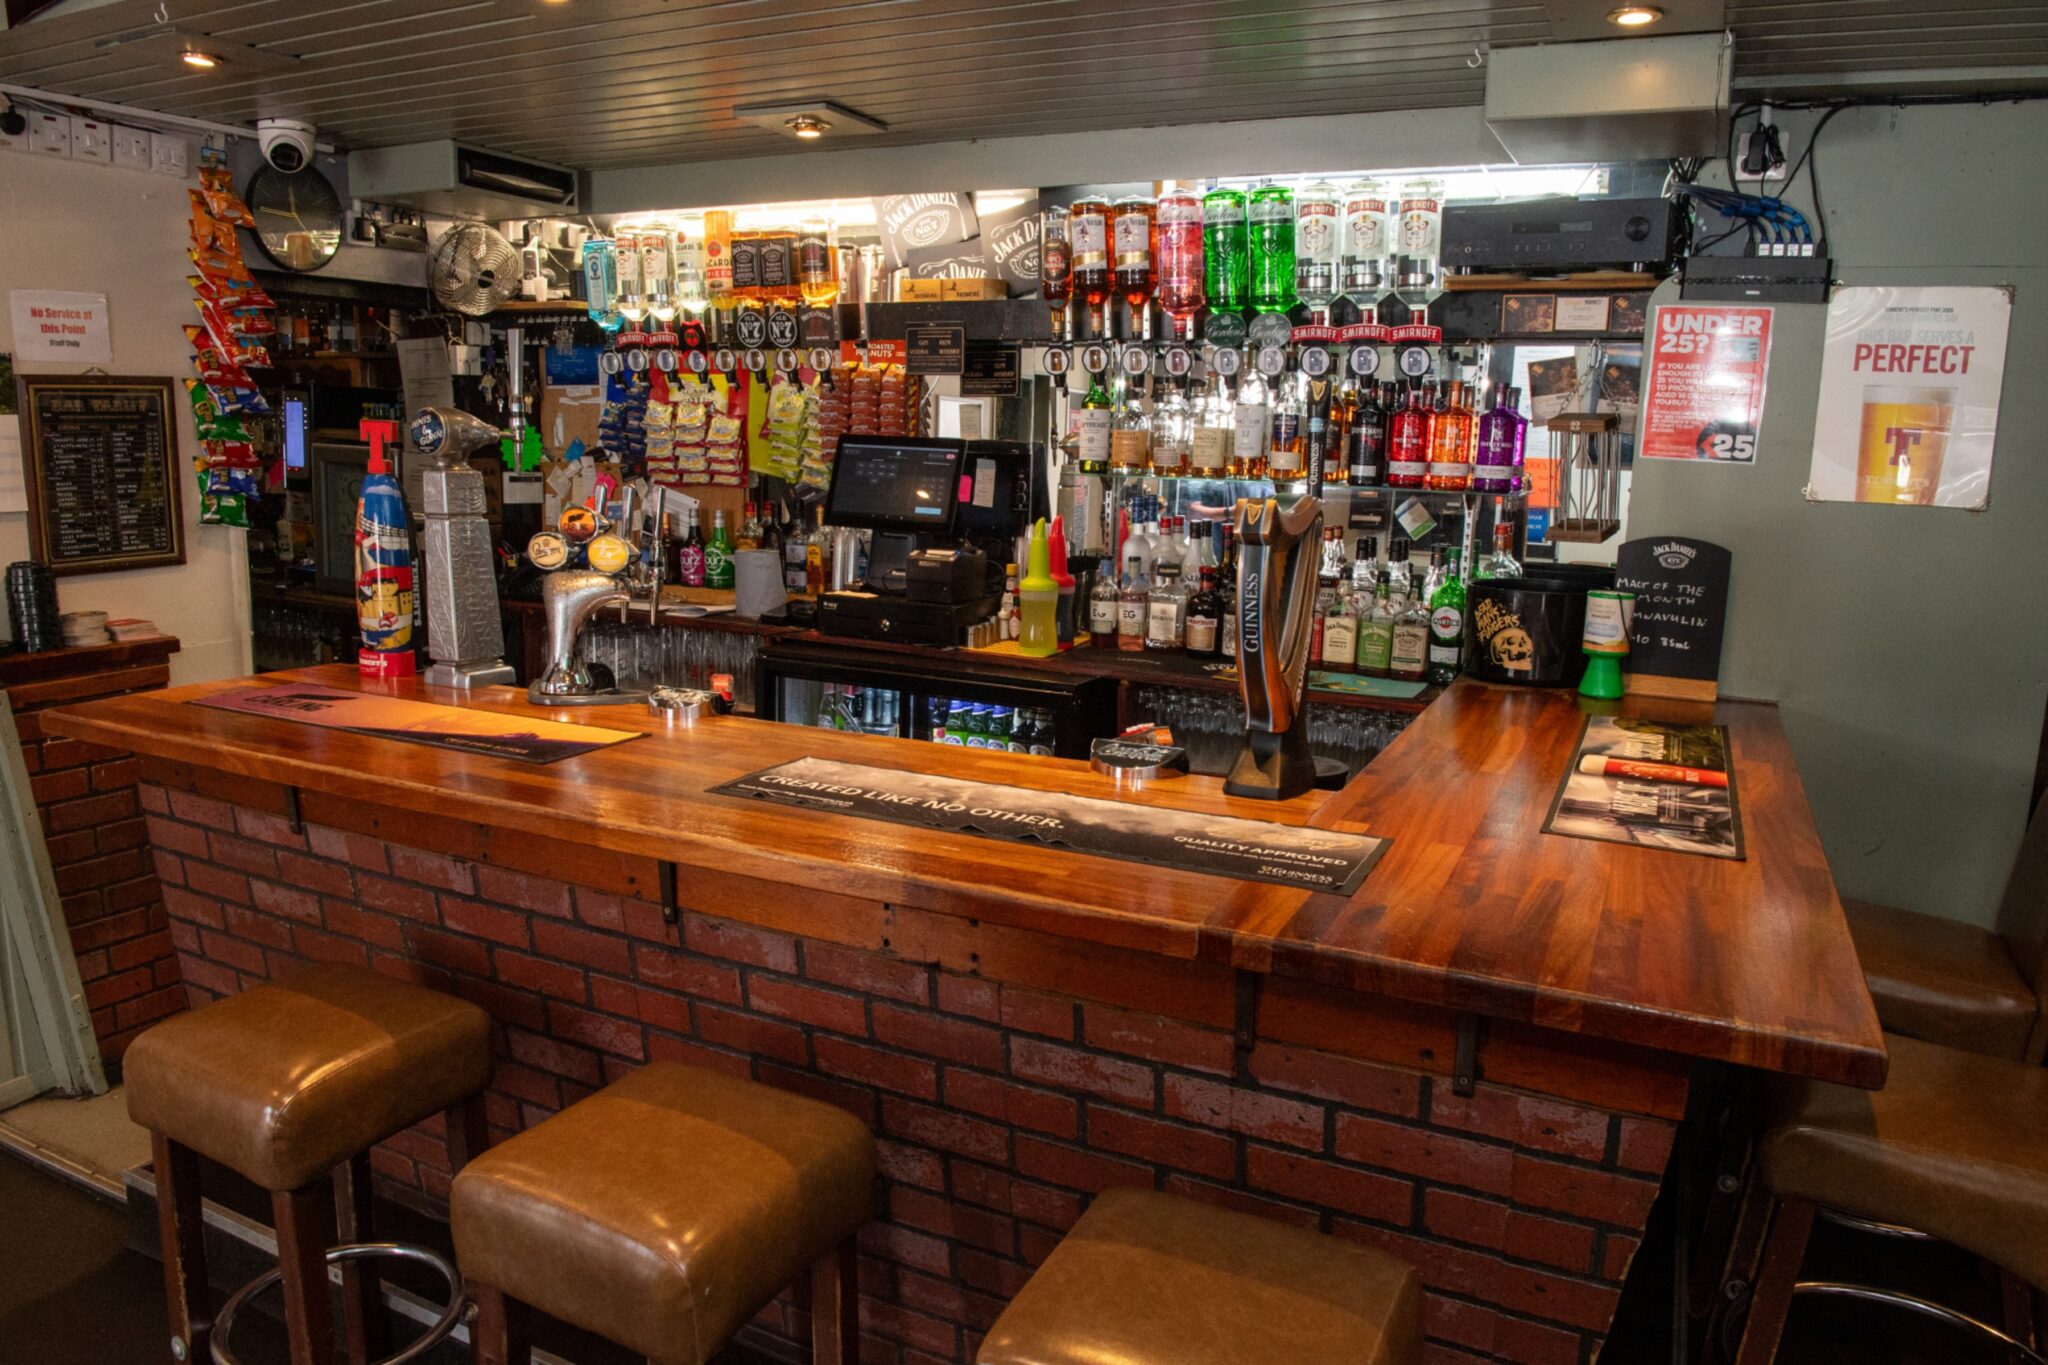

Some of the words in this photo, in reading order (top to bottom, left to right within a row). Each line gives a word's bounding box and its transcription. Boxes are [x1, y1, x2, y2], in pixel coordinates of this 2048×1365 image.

[884, 200, 911, 234] JACK
[991, 229, 1024, 264] JACK
[31, 307, 43, 318] No
[44, 308, 81, 319] Service
[83, 310, 93, 320] at
[40, 323, 60, 334] this
[61, 324, 86, 335] Point
[1662, 313, 1763, 335] UNDER
[1294, 329, 1338, 340] SMIRNOFF
[1342, 326, 1386, 339] SMIRNOFF
[1392, 327, 1437, 340] SMIRNOFF
[1917, 330, 1964, 343] SERVES
[1966, 331, 1975, 344] A
[1660, 334, 1710, 354] 25?
[1853, 343, 1976, 374] PERFECT
[1657, 369, 1692, 377] ENOUGH
[1656, 384, 1667, 392] TO
[1668, 385, 1696, 393] PROVE
[1671, 399, 1688, 407] BUY
[1713, 434, 1754, 460] 25
[1309, 442, 1319, 486] GUINNESS
[1653, 544, 1670, 557] JACK
[1671, 542, 1697, 559] DANIEL'S
[412, 557, 422, 628] TENNENT'S
[1653, 582, 1669, 591] OF
[1677, 584, 1706, 597] THE
[1637, 594, 1696, 606] MONTH
[1122, 609, 1136, 619] EG
[1244, 572, 1260, 653] GUINNESS
[1478, 614, 1520, 642] FINGERS
[759, 775, 863, 796] CREATED
[863, 790, 923, 806] LIKE
[923, 799, 966, 813] NO
[970, 808, 1065, 830] OTHER.
[1173, 835, 1250, 851] QUALITY
[1250, 848, 1348, 867] APPROVED
[1272, 867, 1333, 883] GUINNESS
